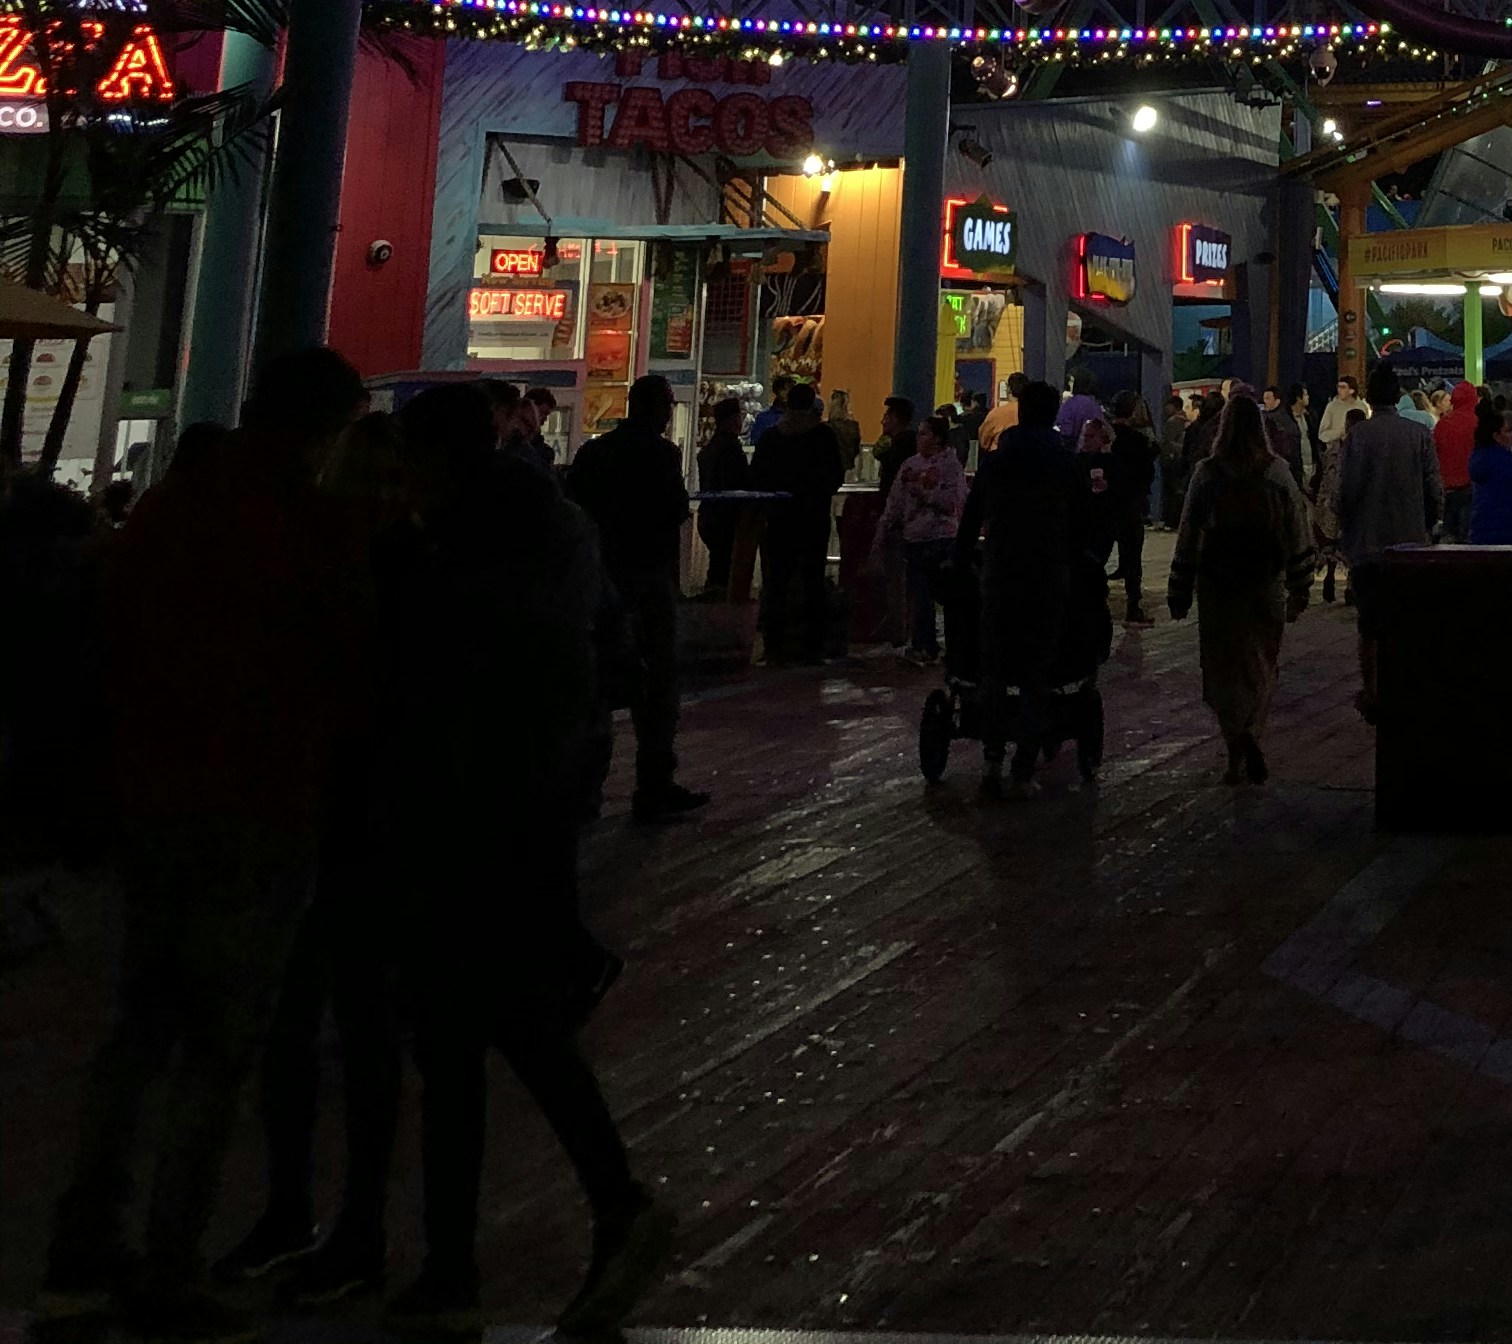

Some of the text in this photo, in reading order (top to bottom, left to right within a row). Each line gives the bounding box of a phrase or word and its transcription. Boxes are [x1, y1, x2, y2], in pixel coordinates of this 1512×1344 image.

[564, 81, 815, 158] TACOS
[963, 217, 1011, 255] GAMES
[494, 252, 538, 273] OPEN
[1195, 239, 1228, 269] PRIZES
[470, 290, 565, 317] SOFT SERVE
